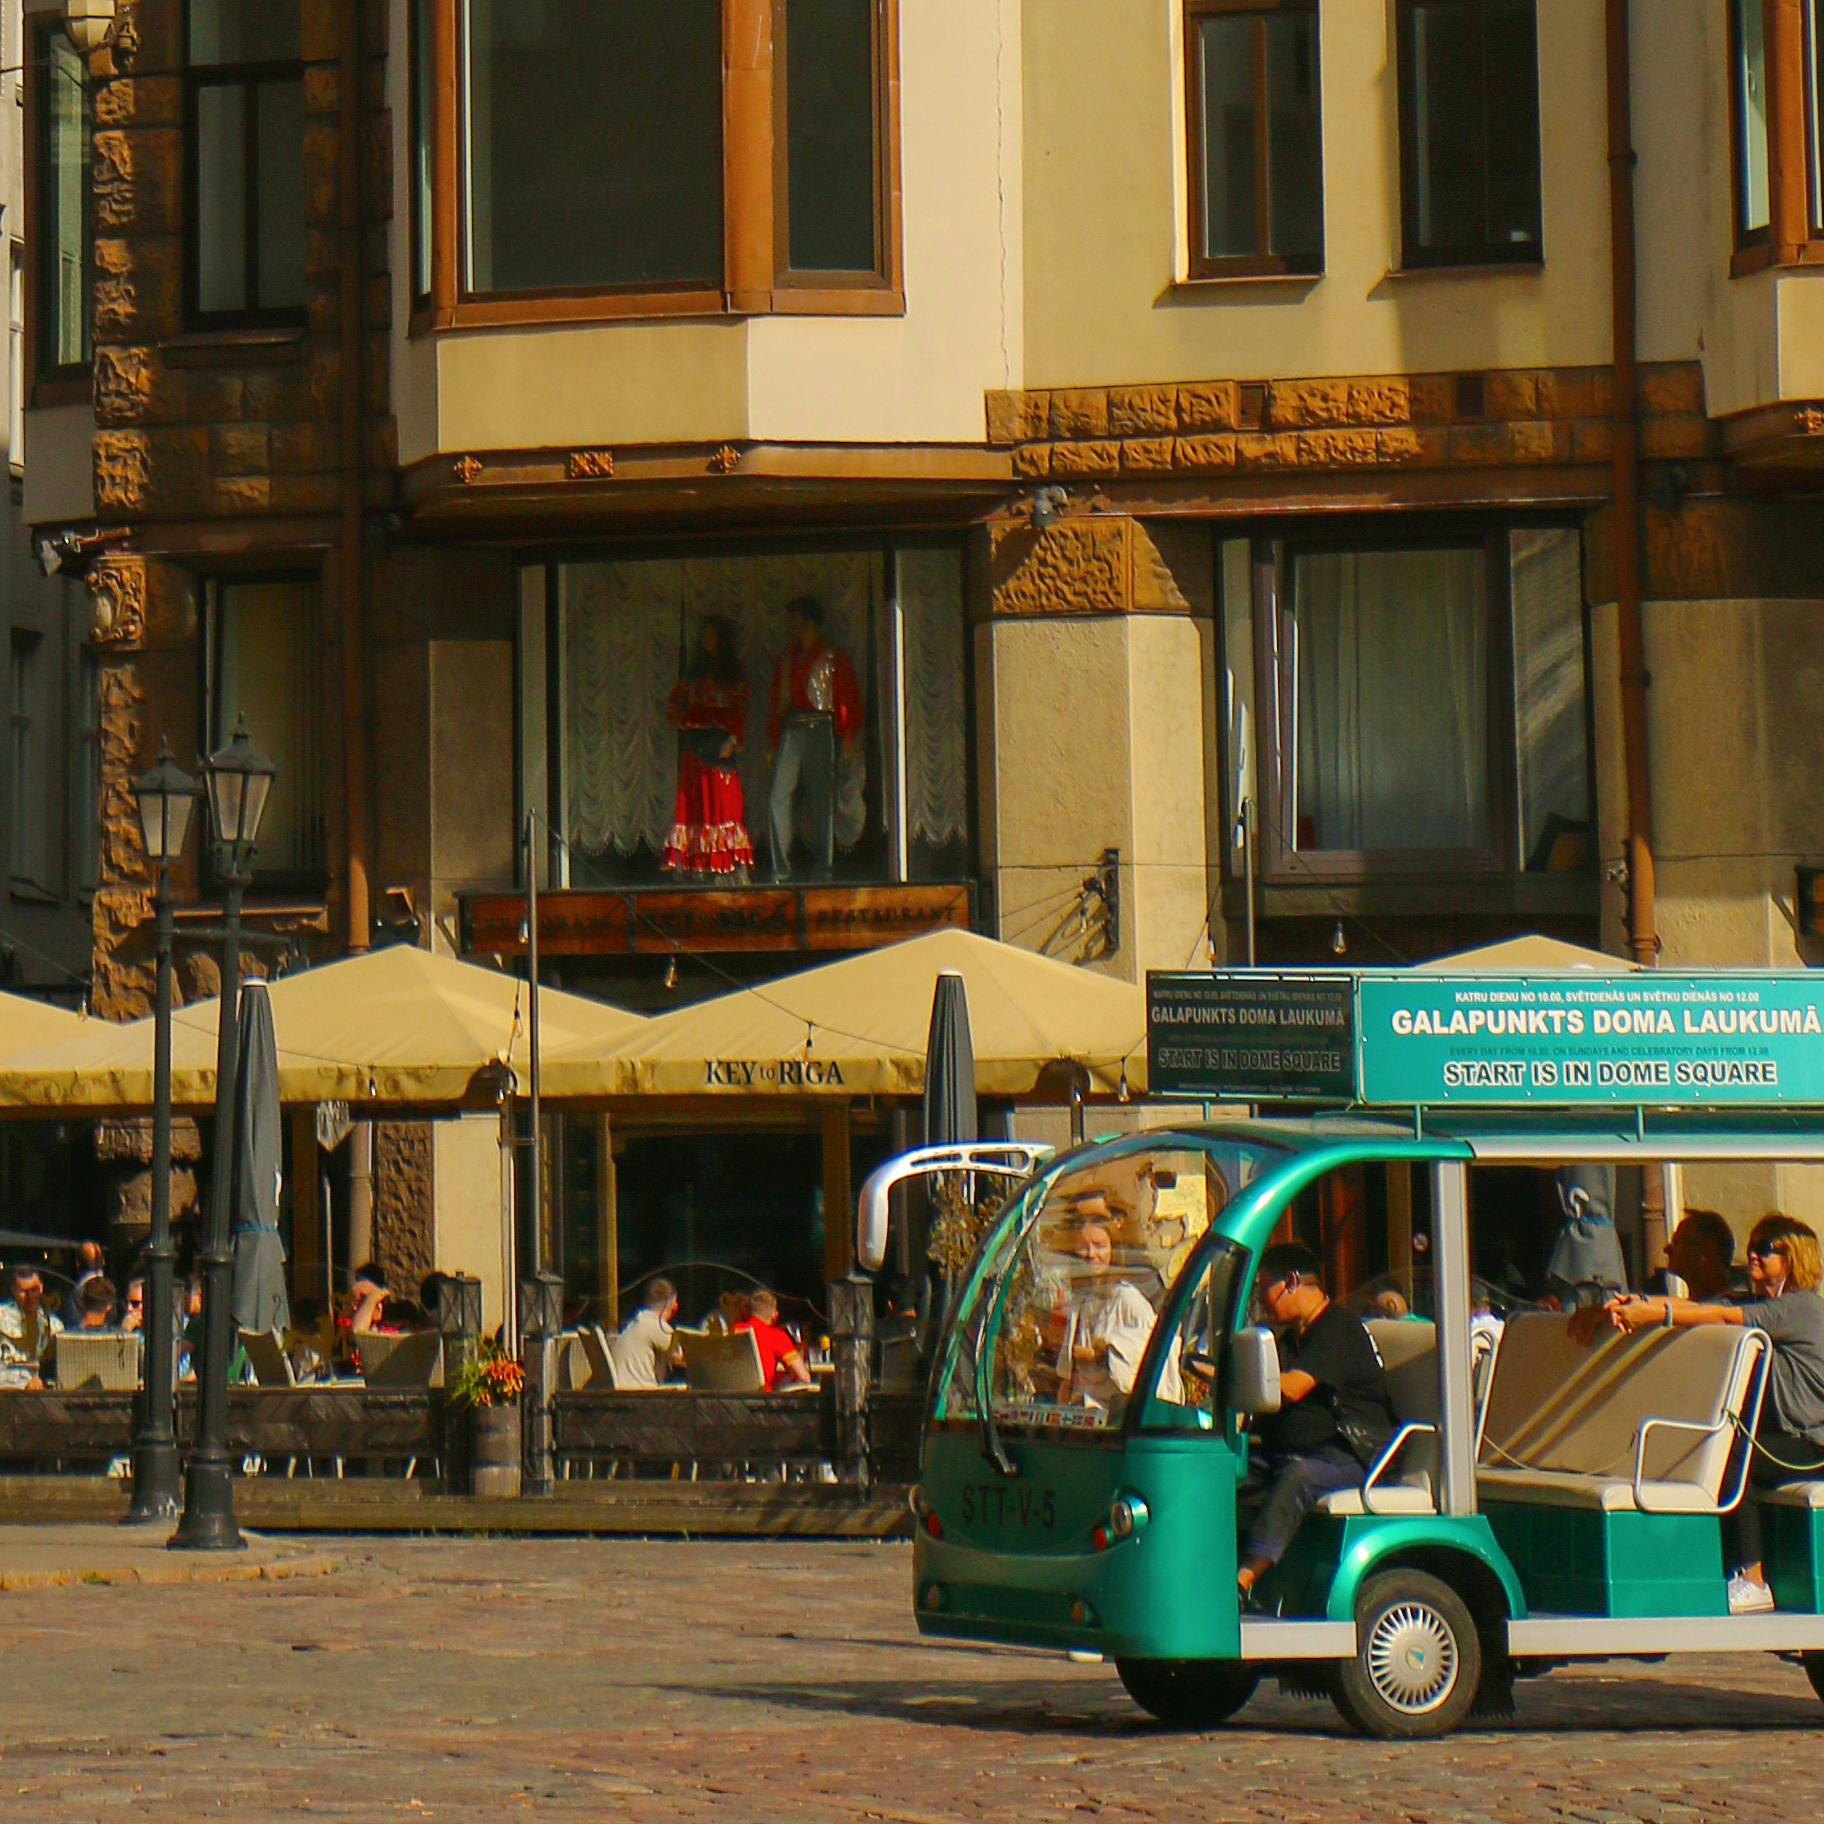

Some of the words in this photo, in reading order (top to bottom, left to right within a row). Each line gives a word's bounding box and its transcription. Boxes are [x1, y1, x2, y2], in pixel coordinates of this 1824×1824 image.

[1455, 991, 1487, 1003] KATRU
[1490, 991, 1519, 1003] DIENU
[1521, 991, 1535, 1003] NO
[1627, 991, 1641, 1003] UN
[1719, 991, 1734, 1003] NO
[1736, 991, 1760, 1003] 12.00
[1152, 1006, 1236, 1025] GALAPUNKTS
[1239, 1008, 1277, 1025] DOMA
[1280, 1007, 1345, 1026] LAUKUMĀ
[1391, 1009, 1585, 1035] GALAPUNKTS
[1593, 1009, 1676, 1035] DOMA
[1684, 1005, 1822, 1035] LAUKUMĀ
[1158, 1048, 1202, 1068] START
[1205, 1049, 1220, 1069] IS
[1222, 1049, 1239, 1069] IN
[1240, 1049, 1280, 1071] DOME
[1282, 1051, 1341, 1072] SQUARE
[1611, 1047, 1628, 1056] AND
[1696, 1047, 1719, 1056] DAYS
[1721, 1047, 1745, 1056] FROM
[705, 1060, 758, 1085] KEY
[759, 1066, 775, 1081] to
[778, 1060, 845, 1085] RIGA
[1443, 1061, 1526, 1086] START
[1531, 1061, 1558, 1086] IS
[1564, 1061, 1592, 1086] IN
[1597, 1061, 1670, 1086] DOME
[1676, 1061, 1778, 1087] SQUARE
